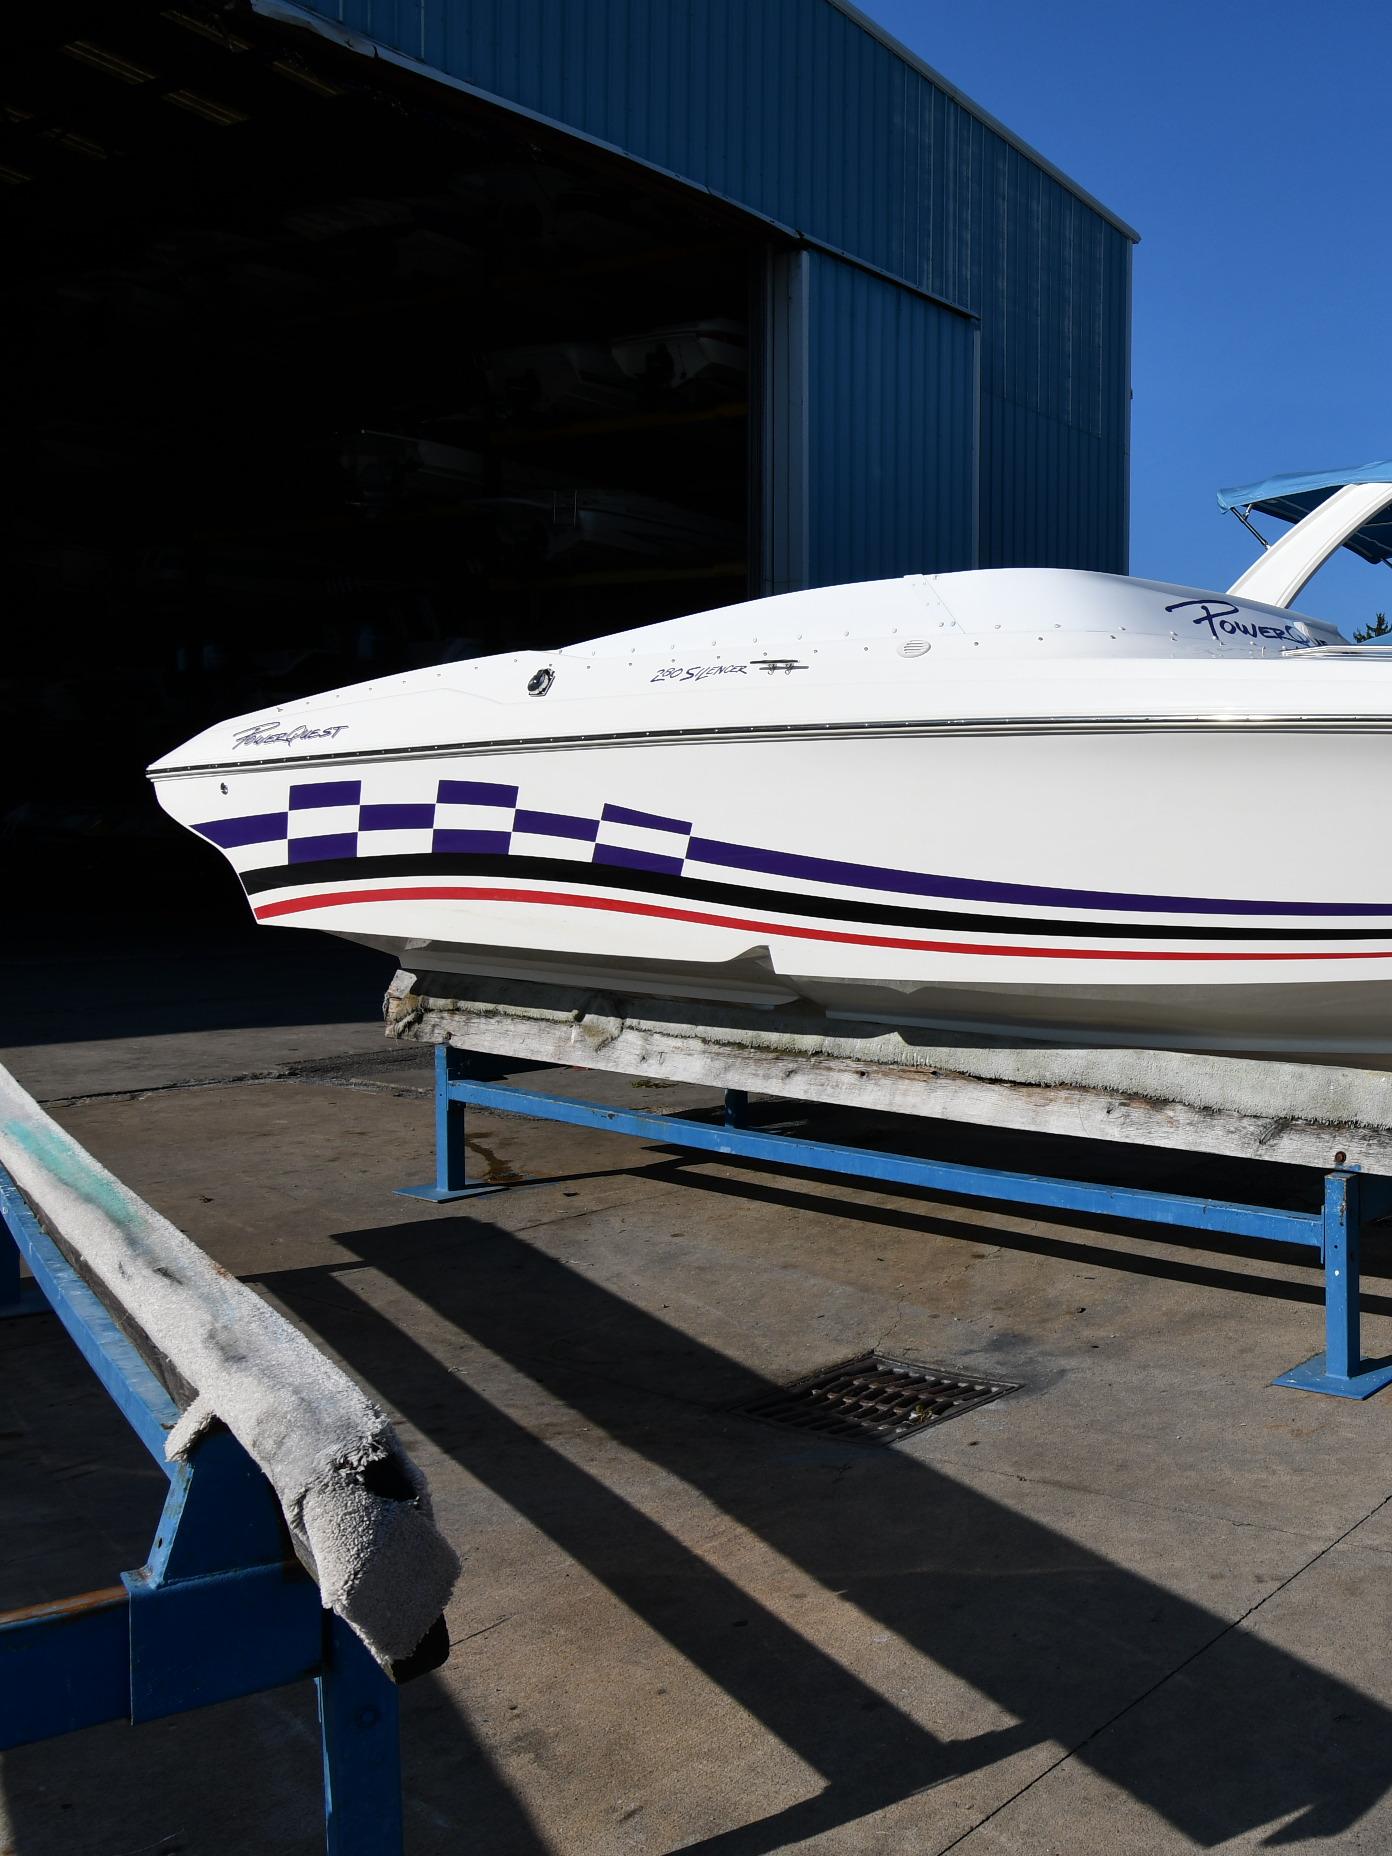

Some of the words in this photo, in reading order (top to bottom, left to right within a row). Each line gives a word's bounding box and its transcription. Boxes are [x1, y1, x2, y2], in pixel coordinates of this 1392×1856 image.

[650, 668, 682, 683] 280
[680, 665, 747, 682] SILENCER
[232, 722, 349, 750] POWERQUEST
